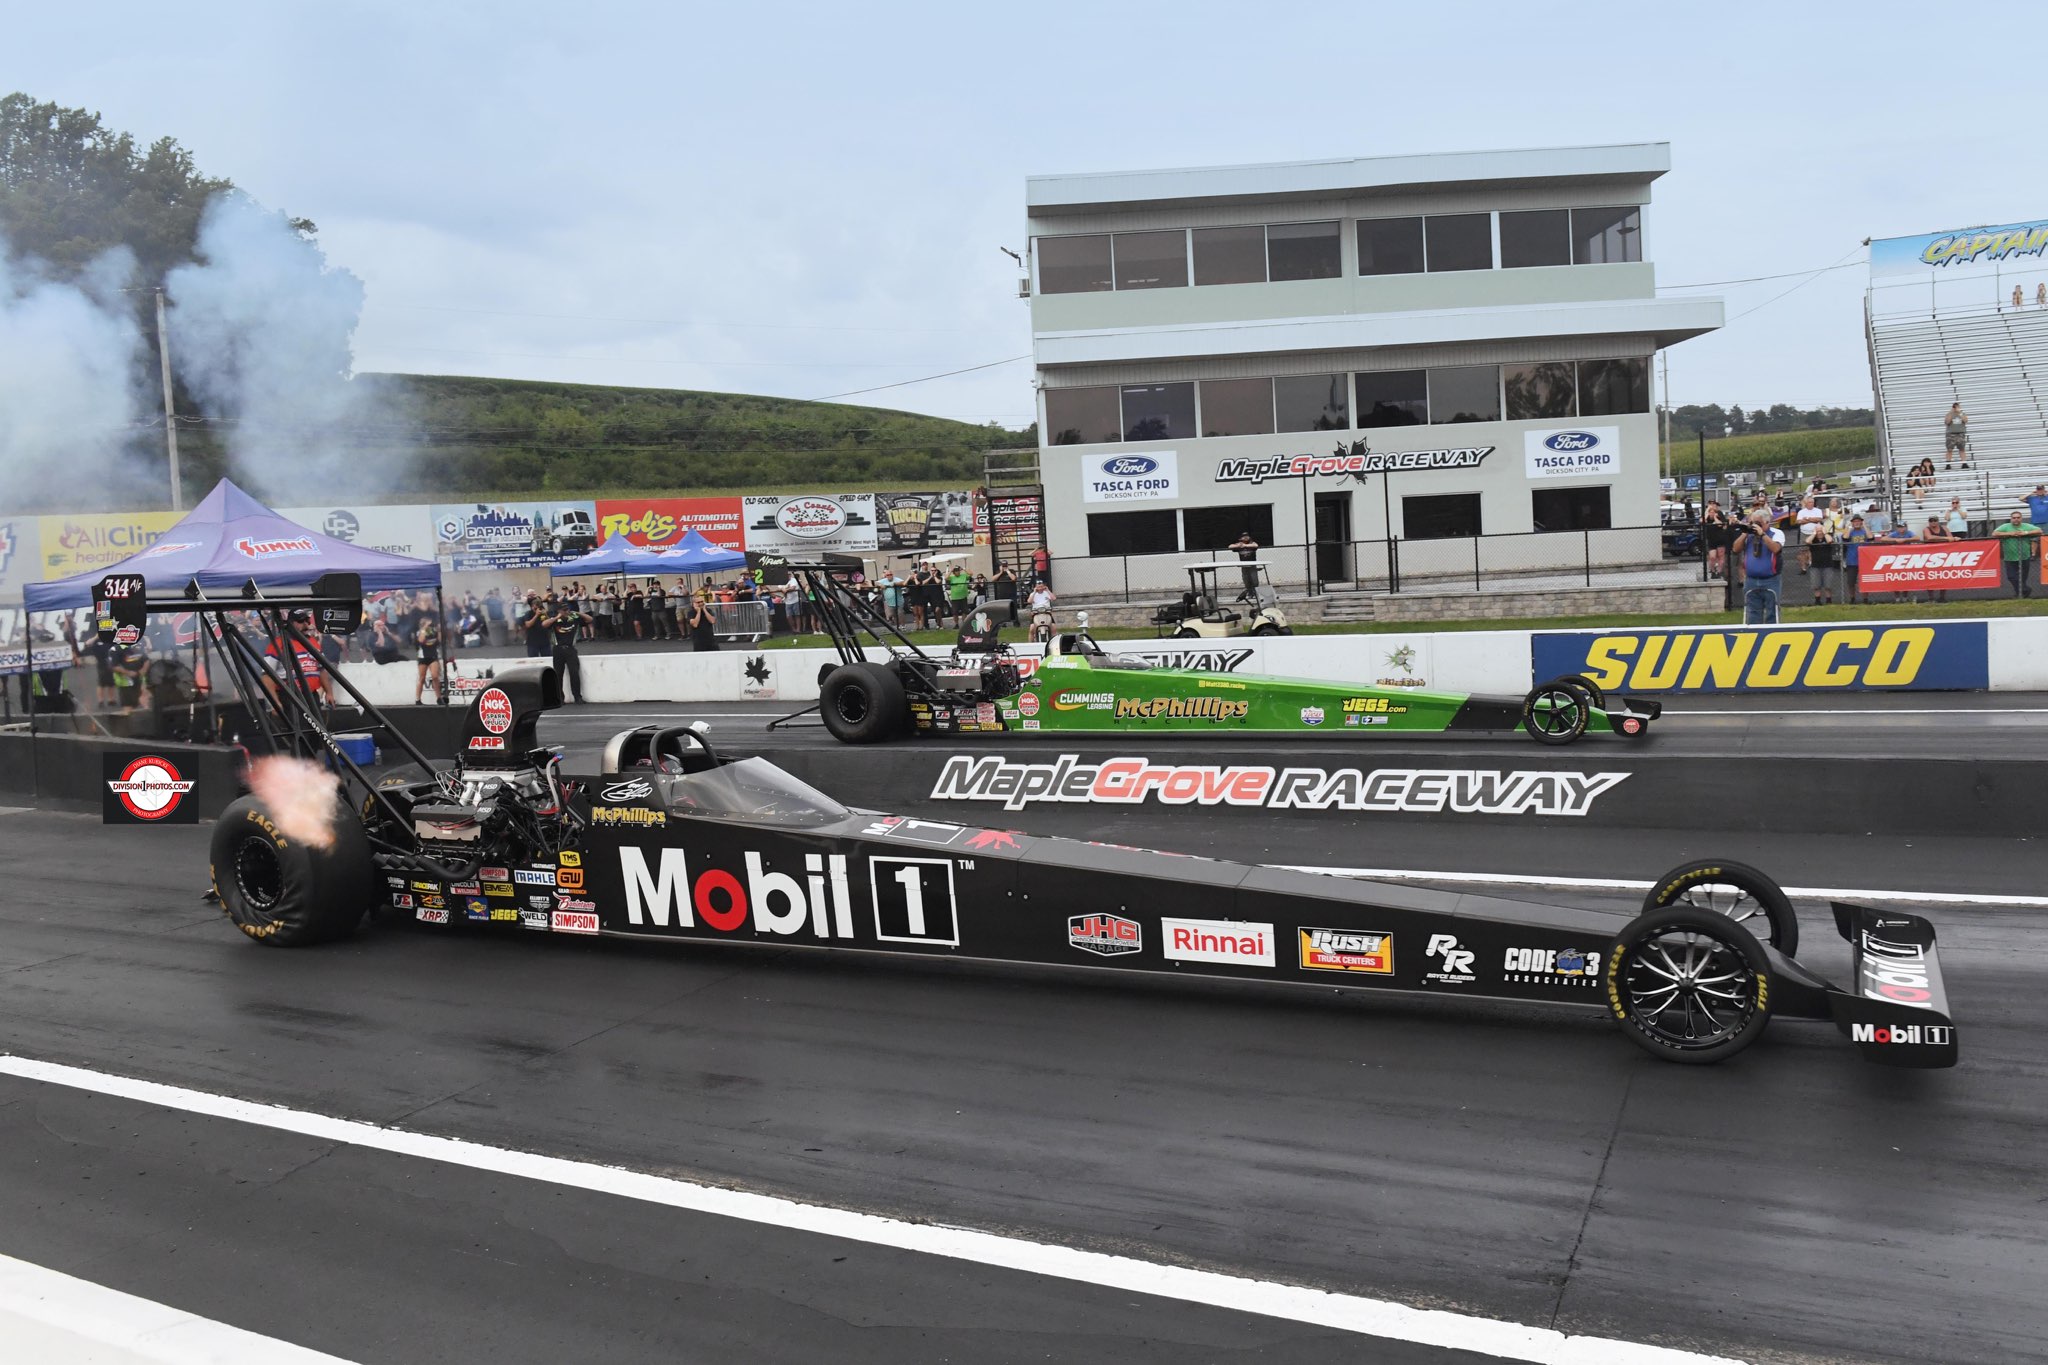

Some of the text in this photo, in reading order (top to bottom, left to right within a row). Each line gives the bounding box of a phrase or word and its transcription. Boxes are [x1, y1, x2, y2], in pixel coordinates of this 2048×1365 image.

[1554, 434, 1589, 449] Ford
[1112, 458, 1148, 474] Ford
[1366, 447, 1495, 472] RACEWAY
[1534, 454, 1611, 468] TASCA FORD
[1093, 479, 1169, 492] TASCA FORD
[745, 497, 780, 505] OLD SCHOOL
[839, 494, 873, 503] SPEED SHOP
[1104, 491, 1133, 499] DICKSON
[679, 513, 740, 522] AUTOMOTIVE
[466, 526, 532, 538] CAPACITY
[681, 522, 738, 532] & COLLISION
[1873, 551, 1984, 570] PENSKE
[754, 568, 764, 584] 2
[1885, 570, 1972, 582] RACING SHOCKS
[104, 578, 129, 598] 314
[1581, 627, 1935, 690] SUNOCO
[484, 699, 506, 710] NGK
[1059, 692, 1114, 704] CUMMINGS
[1114, 697, 1249, 722] McPhillips
[1343, 698, 1407, 713] JEGS.com
[470, 737, 502, 747] ARP
[1271, 772, 1626, 813] RACEWAY
[592, 806, 667, 828] McPhillips
[247, 809, 288, 849] EAGLE
[562, 853, 578, 861] TMS
[481, 867, 506, 877] SIMPSON
[515, 871, 555, 884] MAHLE
[451, 881, 475, 889] LINCOLN
[618, 845, 975, 939] Mobil 1 TM
[422, 909, 443, 921] XRP
[491, 909, 518, 921] JEGS
[524, 912, 547, 921] WELD
[555, 913, 596, 930] SIMPSON
[1071, 916, 1138, 941] JHG
[1081, 942, 1129, 953] GARAGE
[1173, 927, 1264, 956] Rinnai
[1316, 954, 1376, 966] TRUCK CENTERS
[1504, 947, 1600, 976] CODE 3
[1504, 974, 1598, 987] ASSOCIATES
[1755, 973, 1768, 1011] EAGLE
[1851, 1023, 1921, 1044] Mobil
